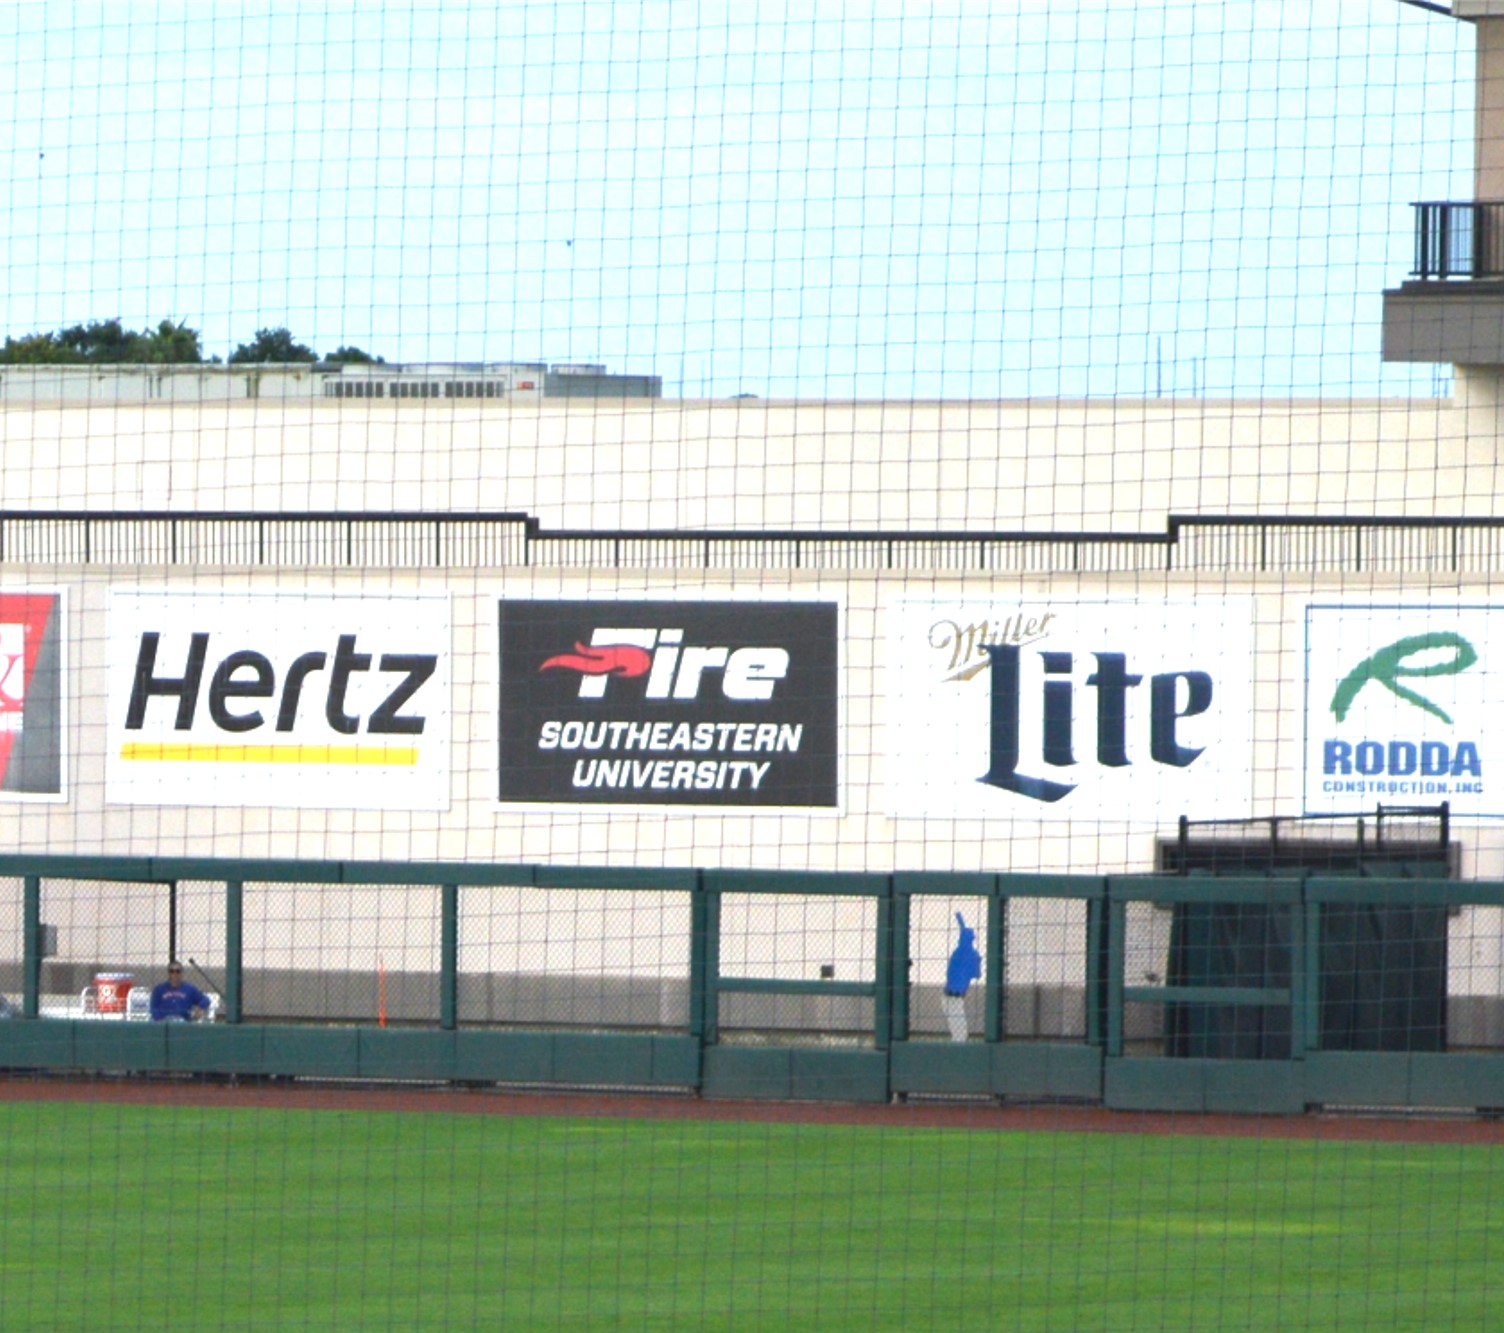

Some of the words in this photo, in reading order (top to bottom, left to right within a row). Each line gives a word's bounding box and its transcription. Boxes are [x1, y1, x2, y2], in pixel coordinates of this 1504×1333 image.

[579, 628, 790, 700] Fire
[928, 611, 1057, 673] Miller
[125, 632, 438, 734] Hertz
[539, 721, 803, 751] SOUTHEASTERN
[975, 644, 1213, 802] Lite
[572, 759, 771, 789] UNIVERSITY
[1323, 741, 1482, 776] RODDA
